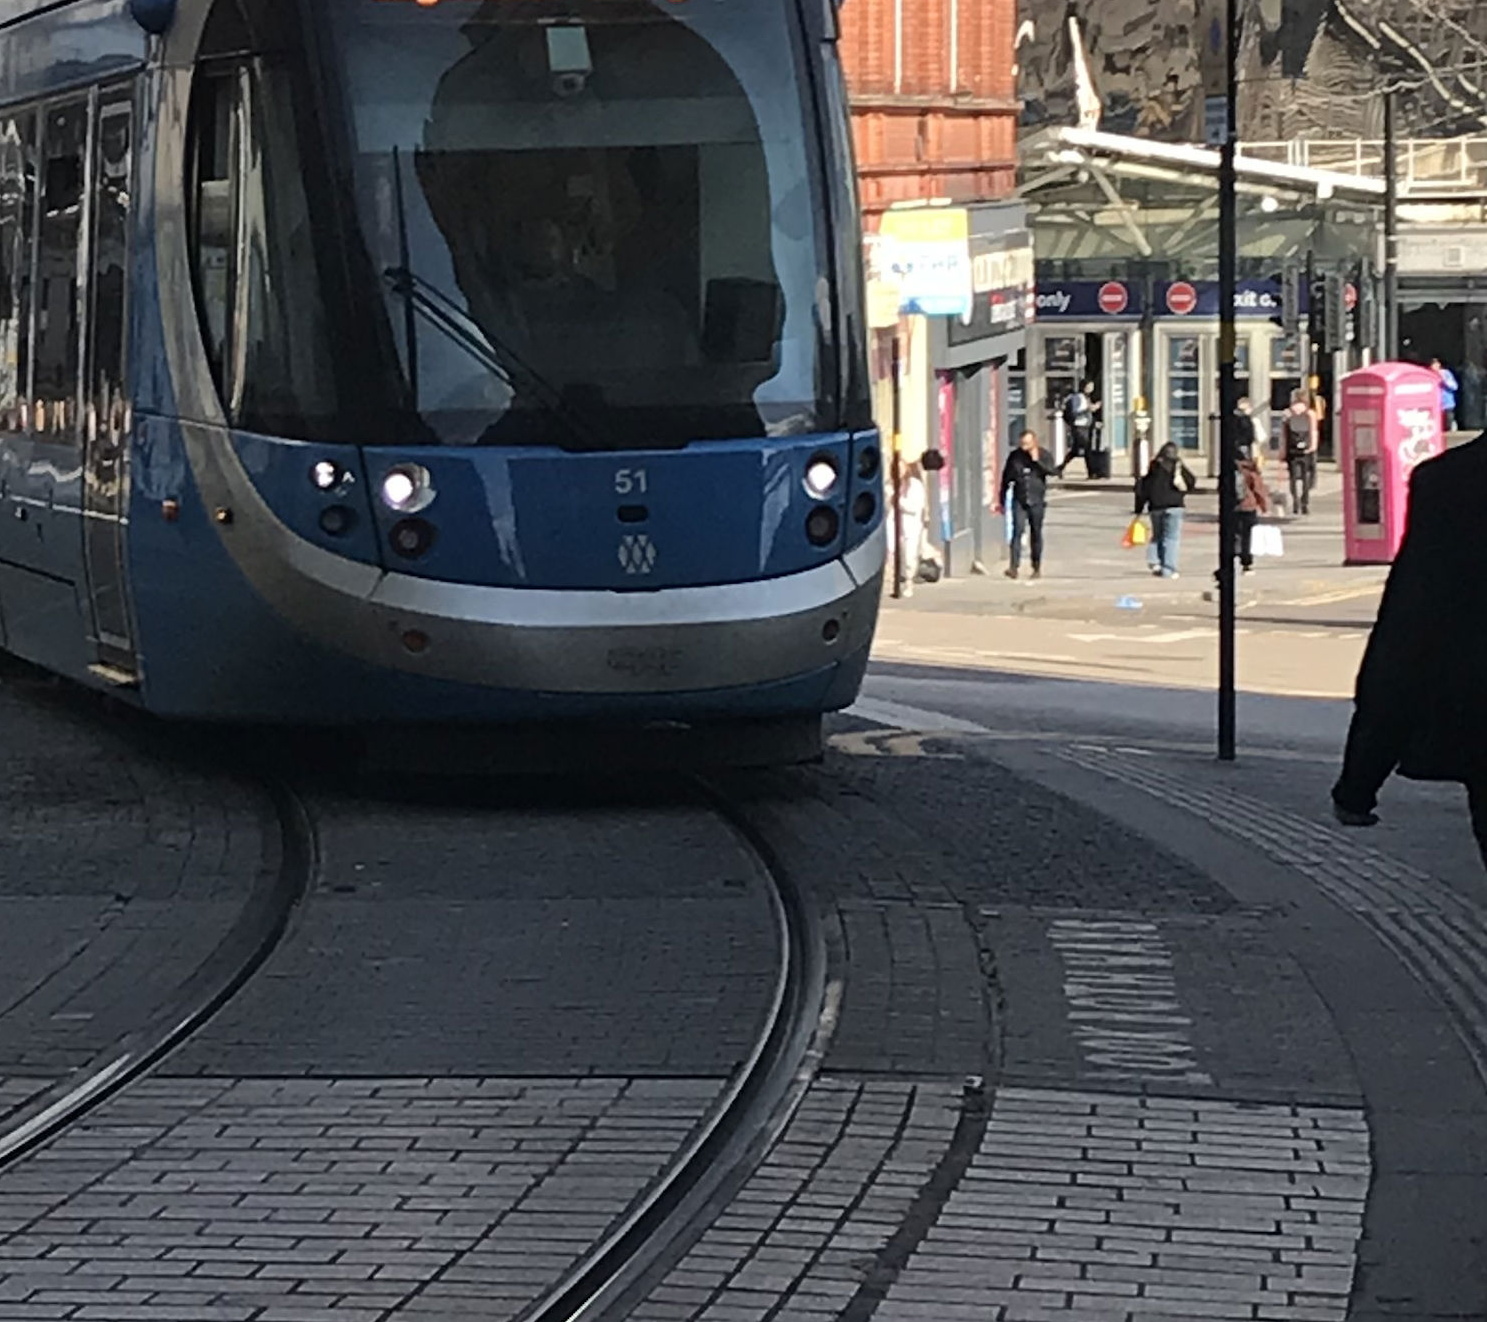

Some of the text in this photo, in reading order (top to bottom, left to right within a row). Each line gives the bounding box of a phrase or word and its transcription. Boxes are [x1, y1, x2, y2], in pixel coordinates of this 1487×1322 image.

[1037, 291, 1071, 312] only
[1233, 289, 1257, 308] xit
[615, 469, 647, 494] 51
